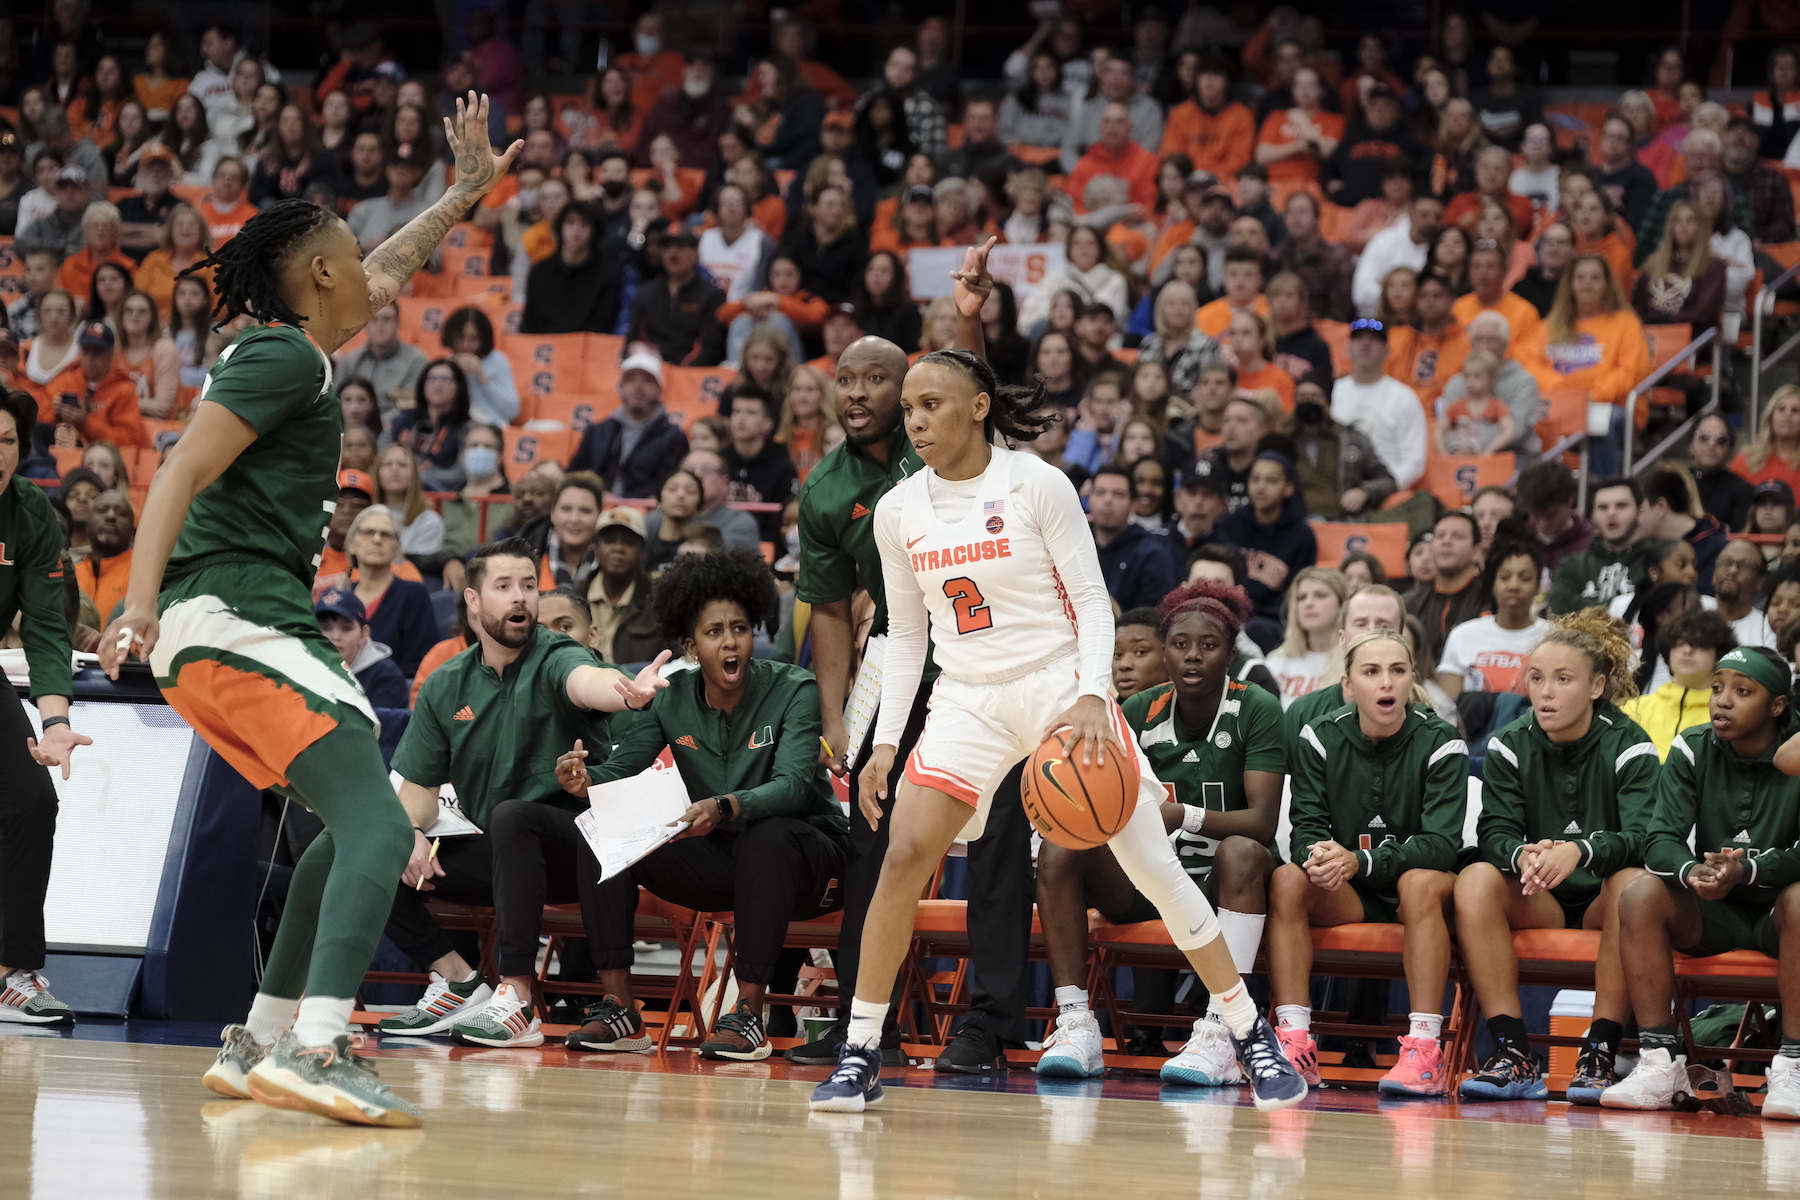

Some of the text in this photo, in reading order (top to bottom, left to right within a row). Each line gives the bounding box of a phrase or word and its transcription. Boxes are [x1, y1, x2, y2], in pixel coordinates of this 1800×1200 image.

[1026, 253, 1047, 285] S
[513, 435, 538, 464] S
[1454, 464, 1479, 495] S
[911, 538, 1012, 573] SYRACUSE
[942, 576, 993, 636] 2
[1022, 773, 1053, 834] ELITE
